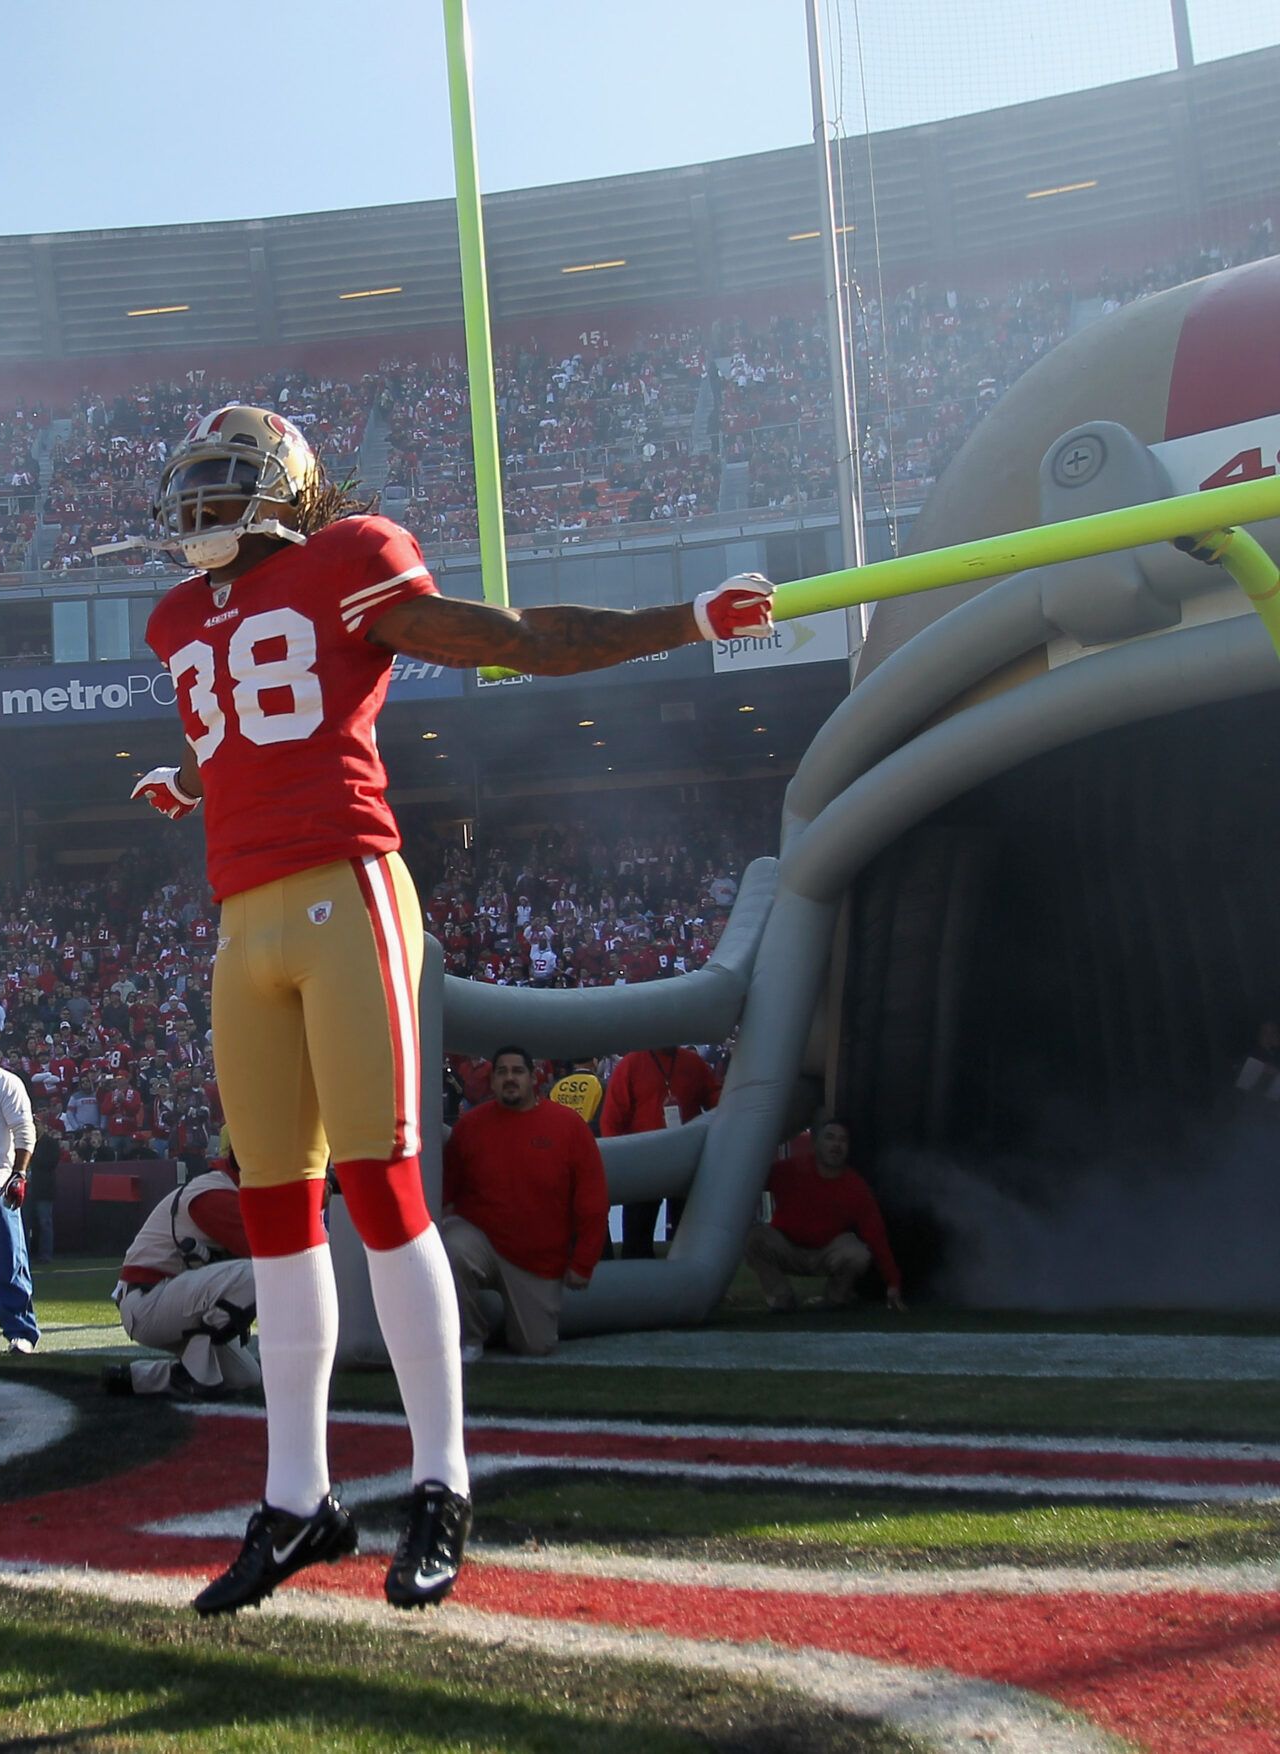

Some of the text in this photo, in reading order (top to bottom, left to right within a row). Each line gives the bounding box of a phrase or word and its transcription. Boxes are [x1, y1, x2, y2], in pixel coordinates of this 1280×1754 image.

[578, 330, 601, 347] 15
[185, 370, 206, 384] 17
[1199, 447, 1280, 492] 4
[65, 503, 76, 512] 51
[1, 672, 178, 715] metroPC
[169, 607, 325, 768] 38
[98, 930, 109, 940] 21
[195, 926, 206, 937] 21
[559, 1081, 589, 1093] CSC
